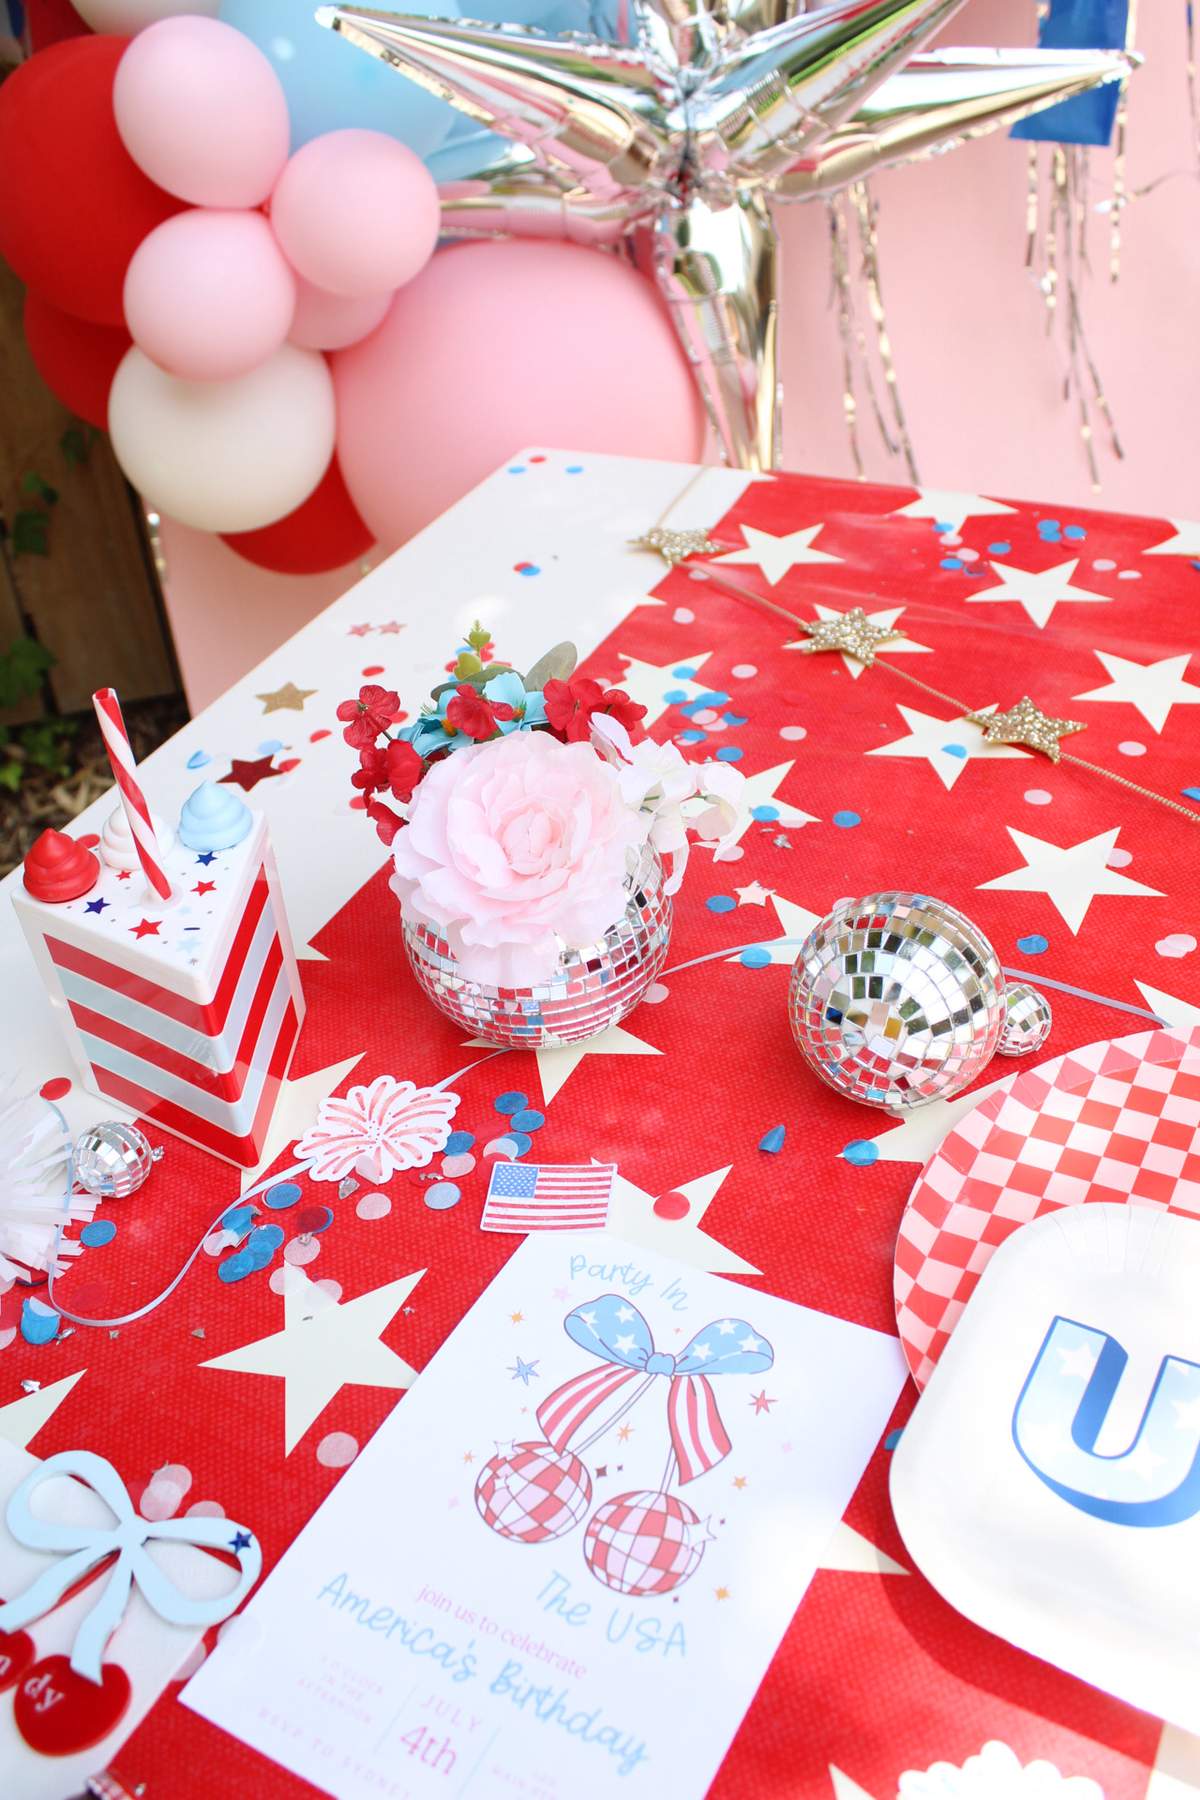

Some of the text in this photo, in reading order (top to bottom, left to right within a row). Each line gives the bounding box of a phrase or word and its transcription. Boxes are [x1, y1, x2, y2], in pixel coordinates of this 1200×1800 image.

[659, 1276, 689, 1312] In
[1011, 1314, 1200, 1527] U
[415, 1582, 588, 1680] join us to celebrate
[536, 1569, 687, 1658] The USA
[315, 1571, 653, 1777] America's Birthday
[419, 1693, 484, 1734] JULY
[399, 1725, 458, 1777] 4th
